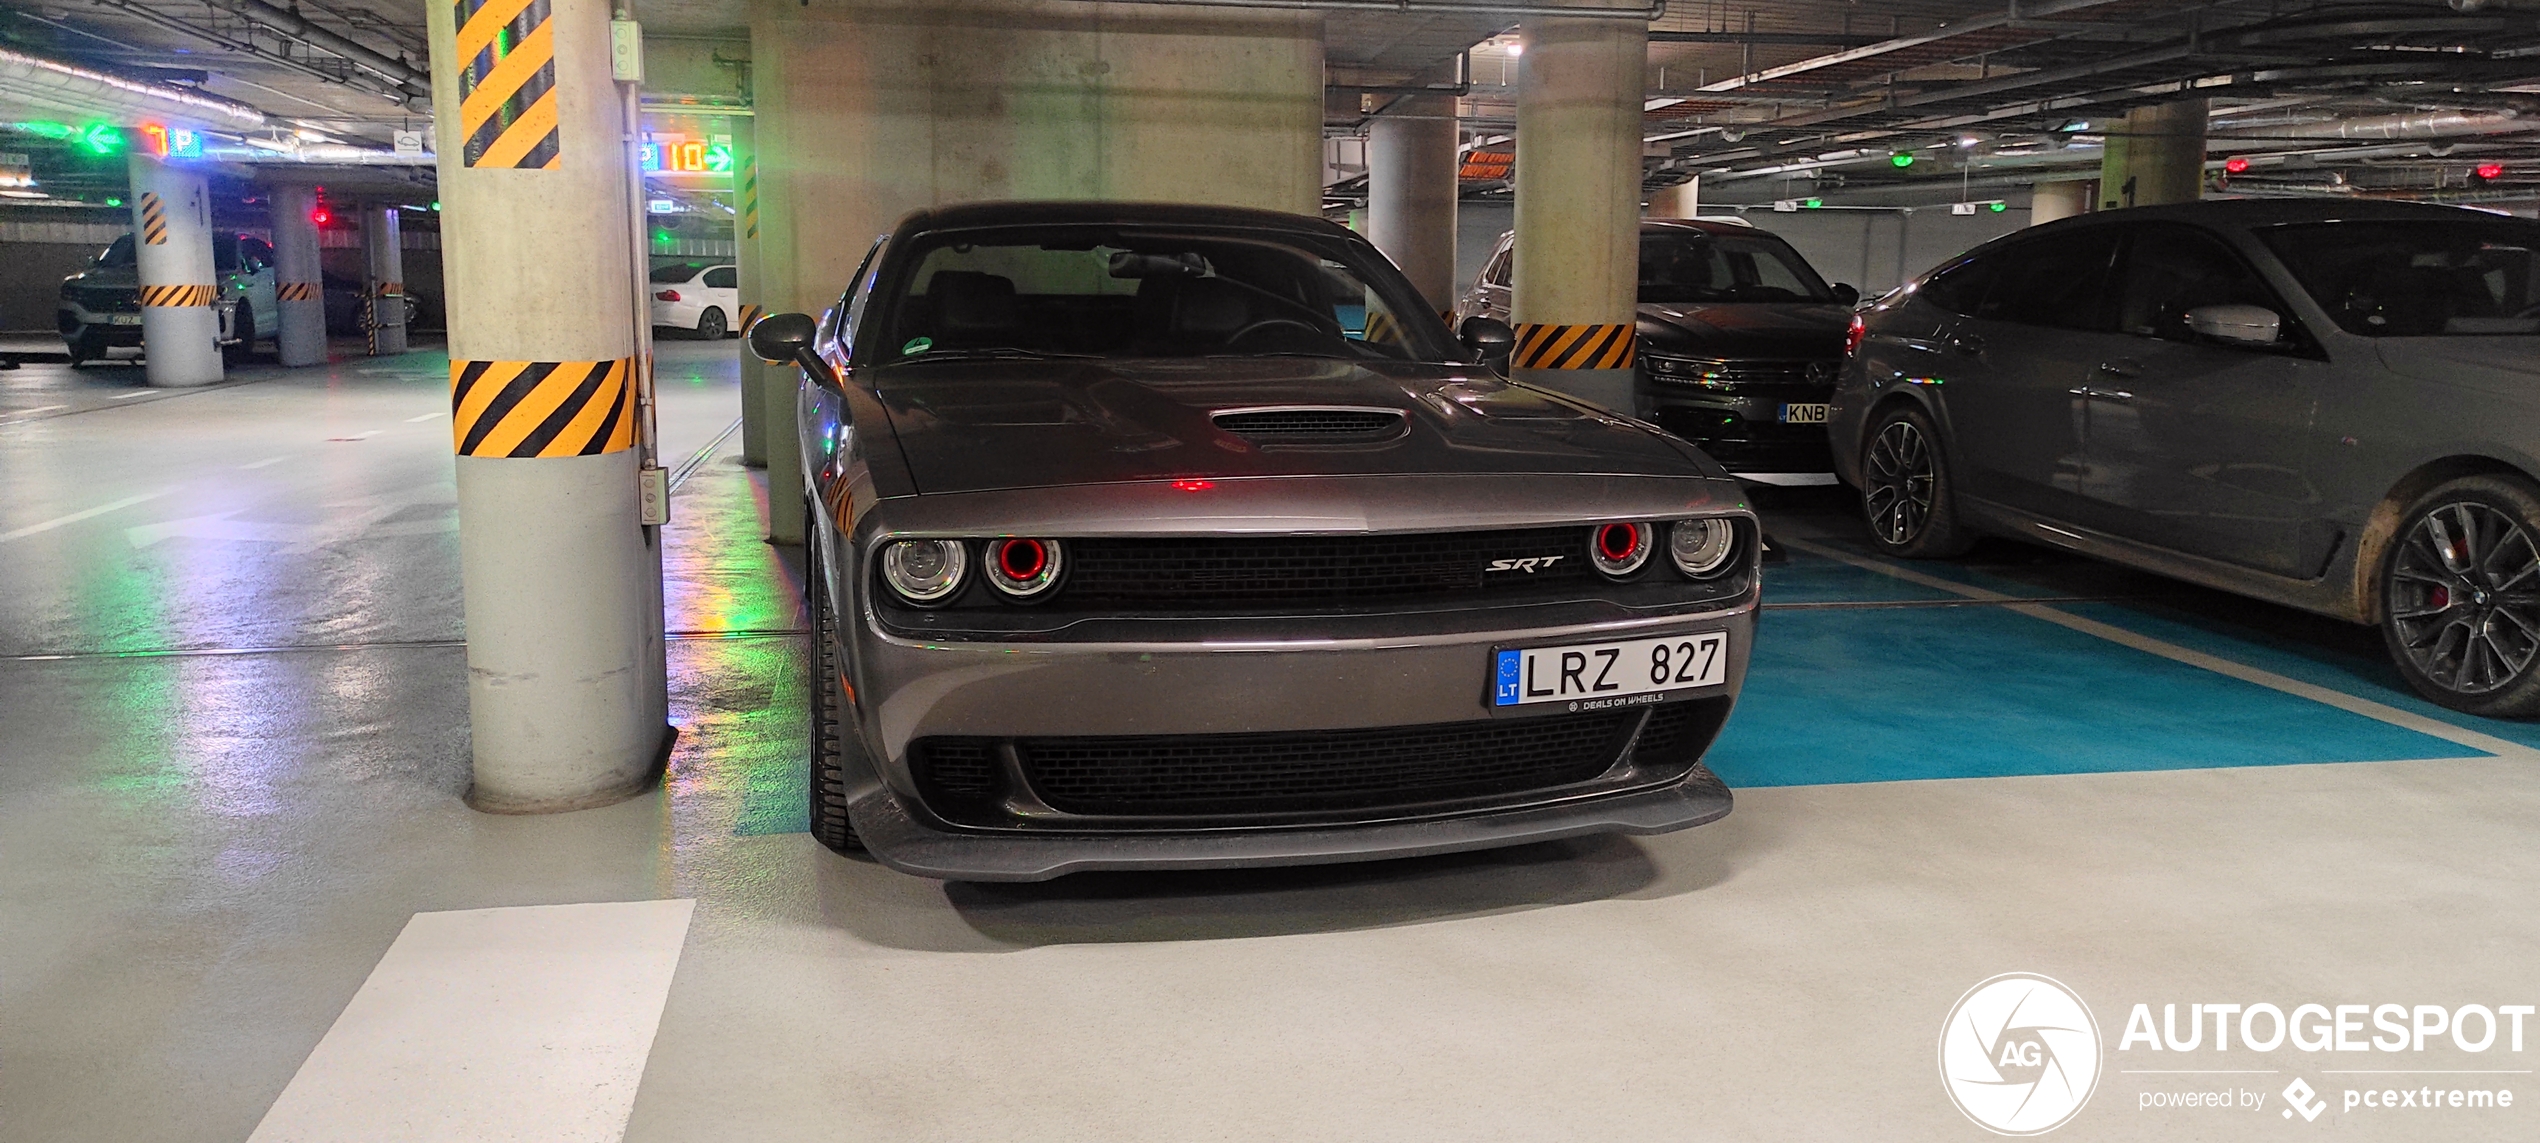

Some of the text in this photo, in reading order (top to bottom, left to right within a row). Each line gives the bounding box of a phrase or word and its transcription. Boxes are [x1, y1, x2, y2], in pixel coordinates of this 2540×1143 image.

[174, 128, 193, 152] P
[671, 143, 703, 171] 10
[1789, 405, 1825, 421] KNB
[1485, 555, 1564, 573] SRT
[1526, 638, 1719, 697] LRZ 827
[1498, 683, 1518, 697] LT
[1583, 693, 1664, 711] DEALS ON WHEELS
